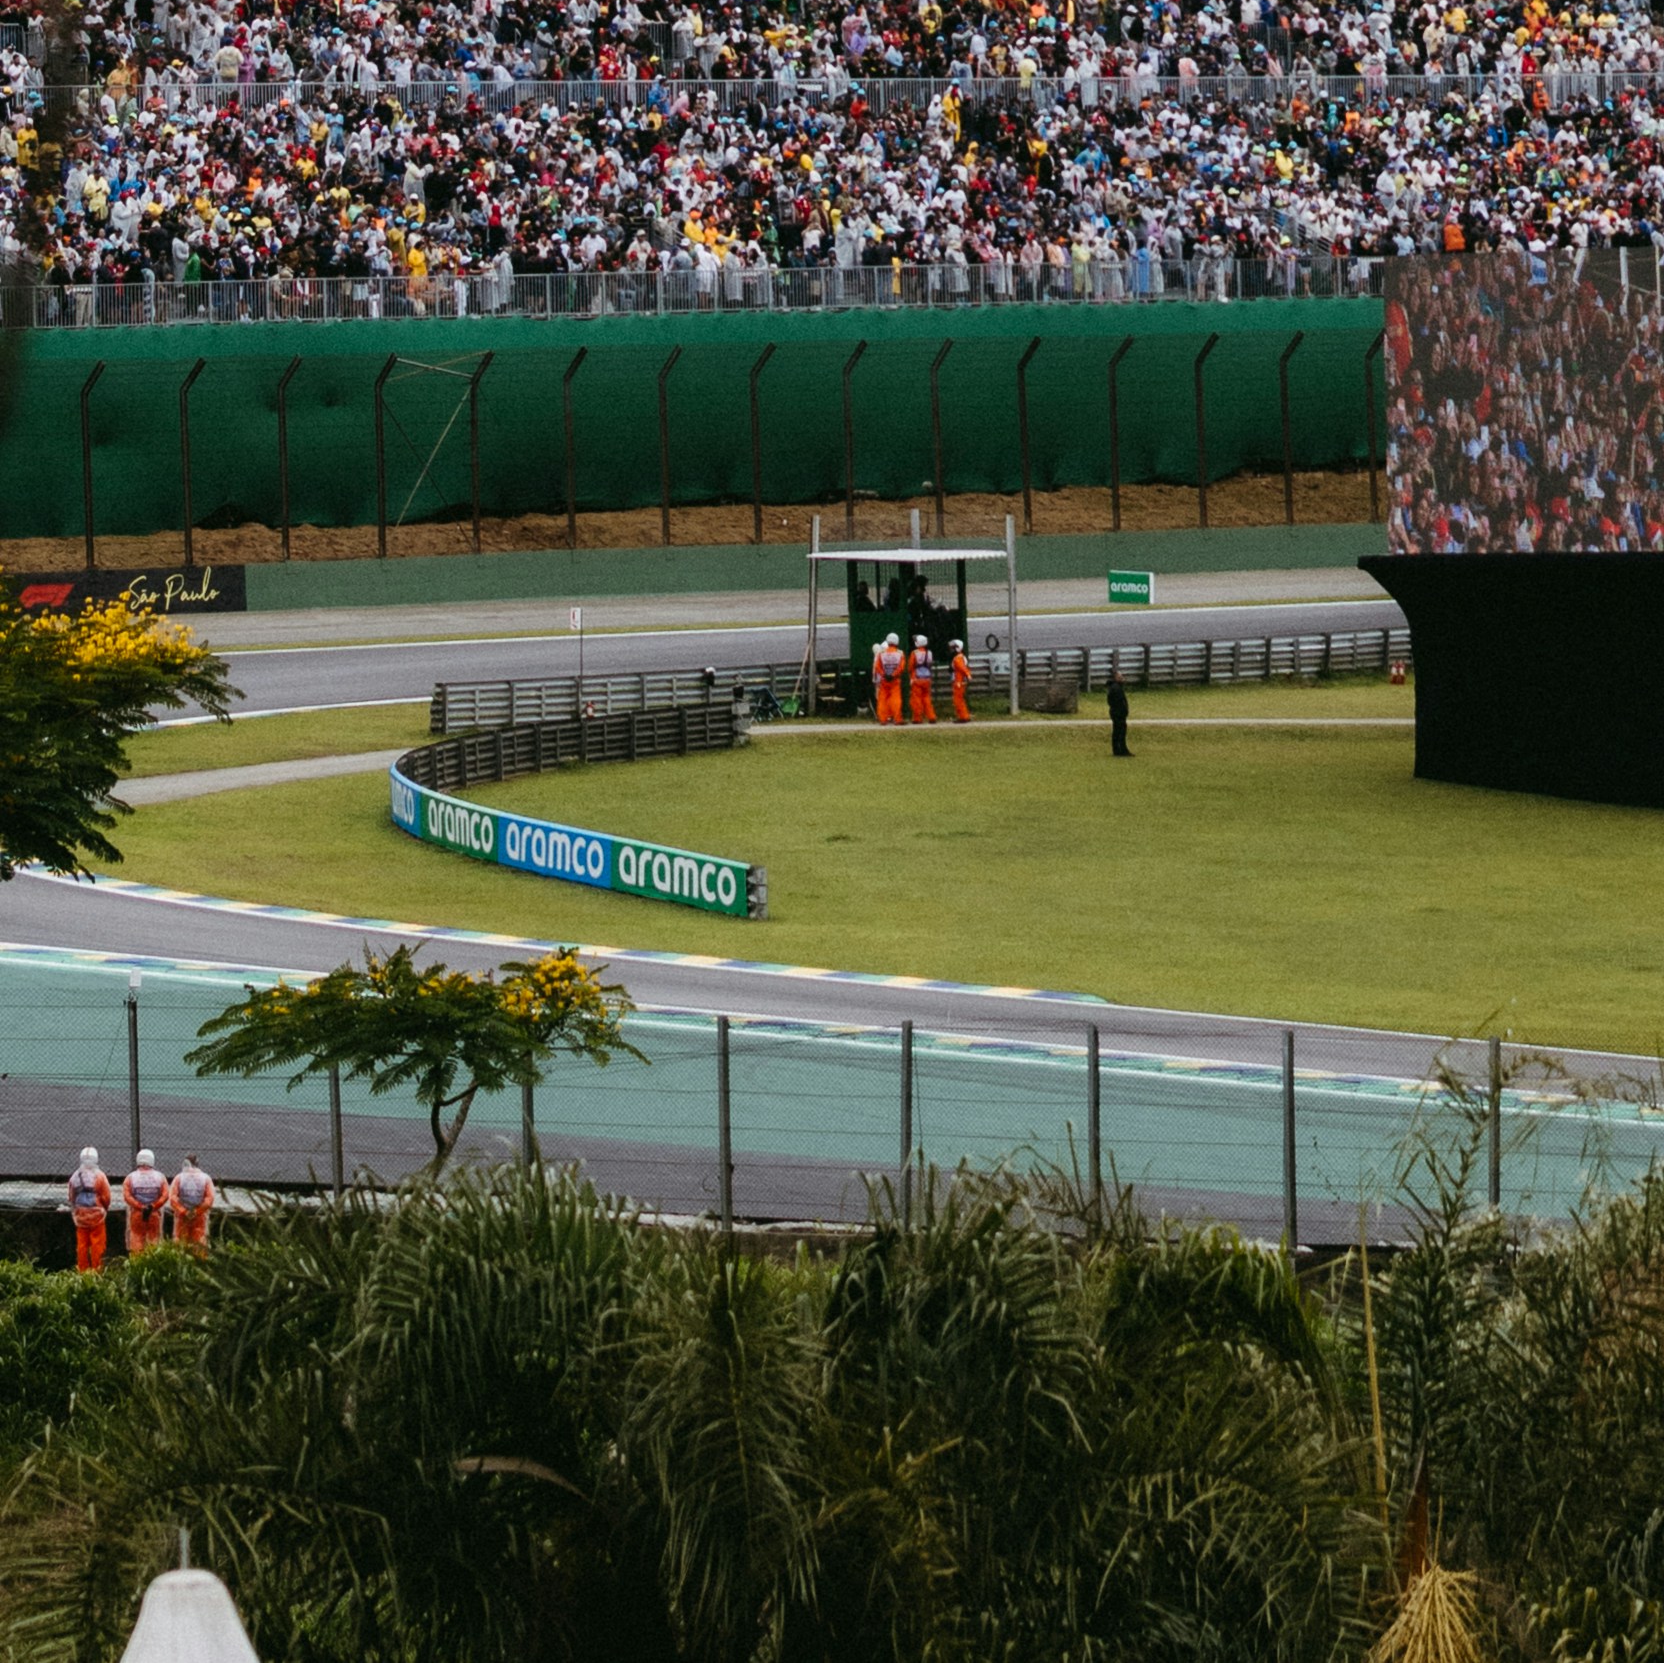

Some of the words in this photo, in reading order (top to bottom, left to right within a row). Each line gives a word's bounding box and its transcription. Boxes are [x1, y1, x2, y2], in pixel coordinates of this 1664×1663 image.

[164, 566, 219, 610] Paulo
[1110, 582, 1149, 593] aramco
[428, 799, 494, 853] aramco
[506, 822, 604, 879] aramco
[619, 845, 737, 906] aramco
